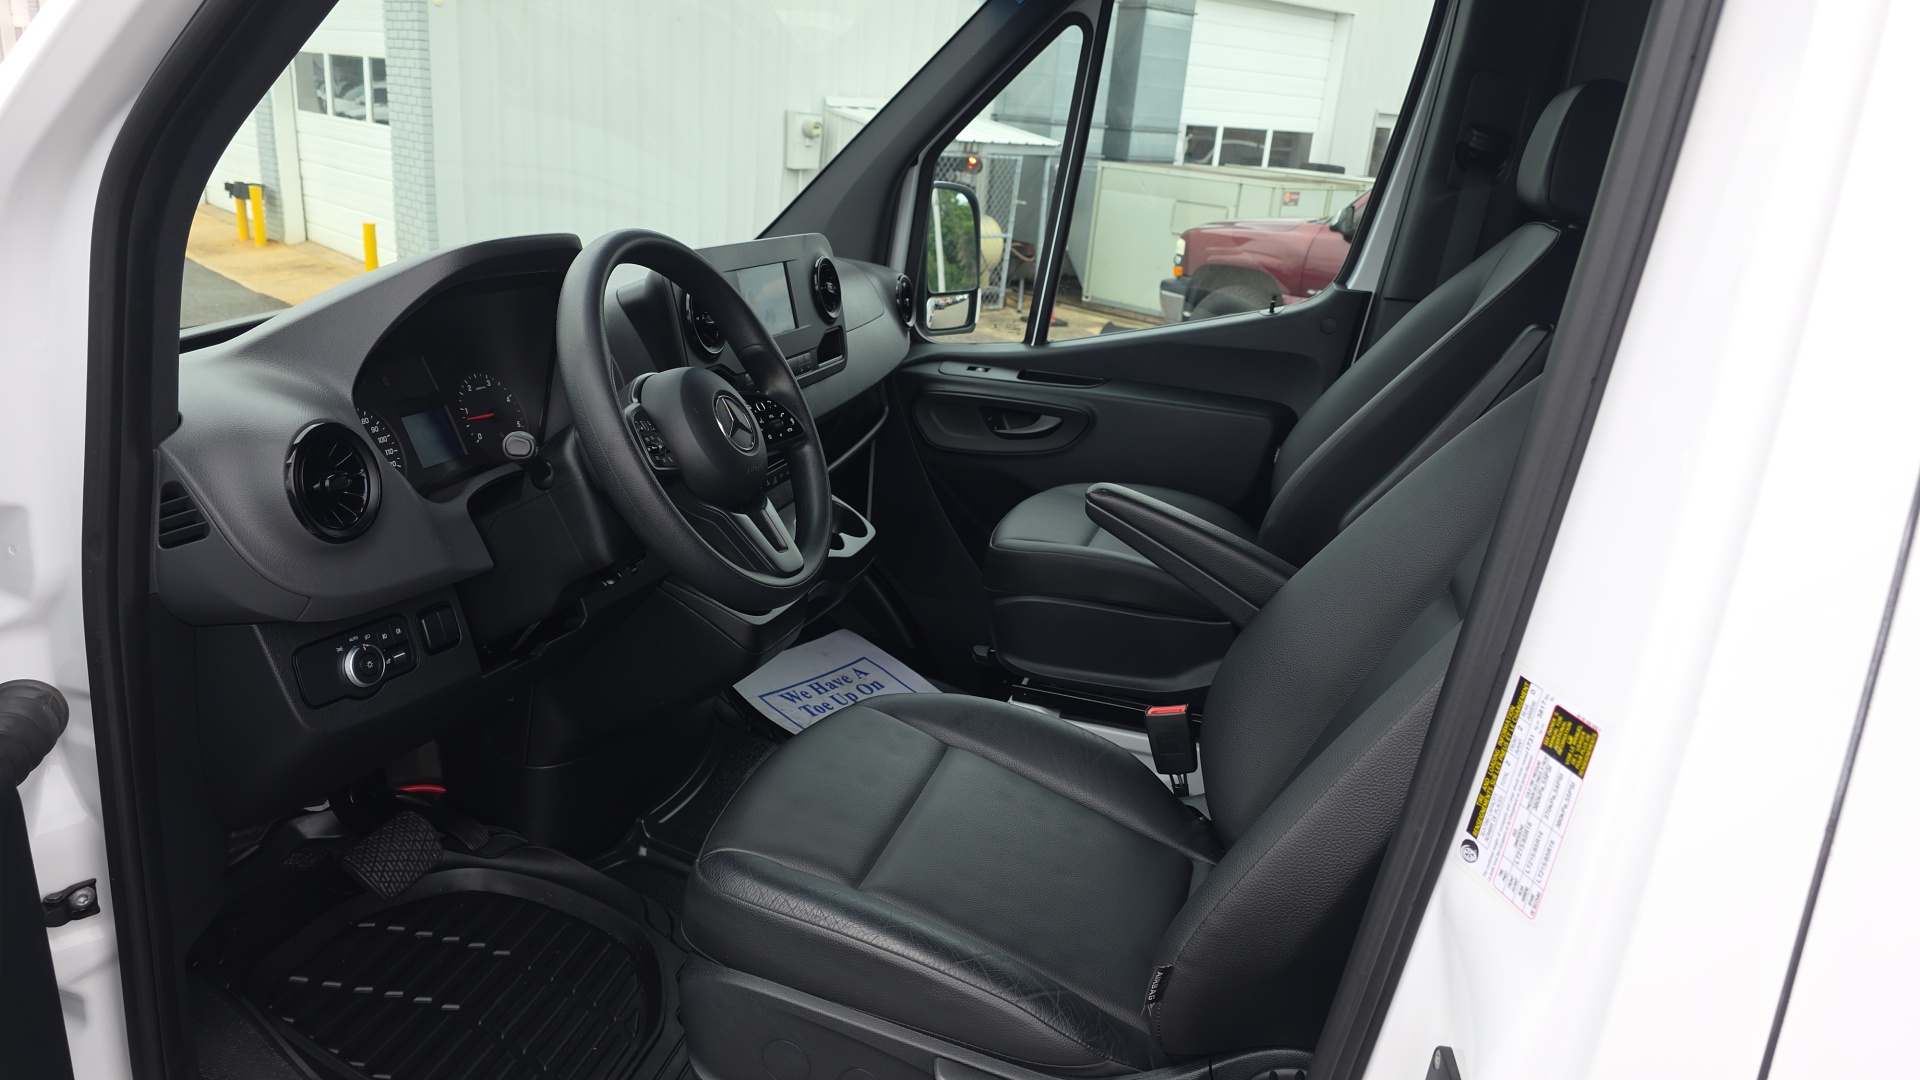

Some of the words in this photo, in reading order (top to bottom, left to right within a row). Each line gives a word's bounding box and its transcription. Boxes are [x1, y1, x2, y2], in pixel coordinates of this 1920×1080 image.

[779, 690, 812, 704] We
[808, 675, 853, 696] Have
[852, 667, 870, 680] A
[798, 701, 834, 718] Toe
[830, 692, 859, 706] Up
[856, 680, 886, 696] On
[1471, 785, 1493, 837] RENSEIGNEMENTS
[1511, 681, 1529, 723] CHARGEMENT
[1476, 793, 1484, 807] TIRE
[1481, 776, 1490, 792] AND
[1486, 748, 1500, 775] LOADING
[1497, 704, 1515, 746] INFORMATION
[1525, 733, 1535, 751] 1731
[1148, 971, 1164, 1001] AIRBAG
